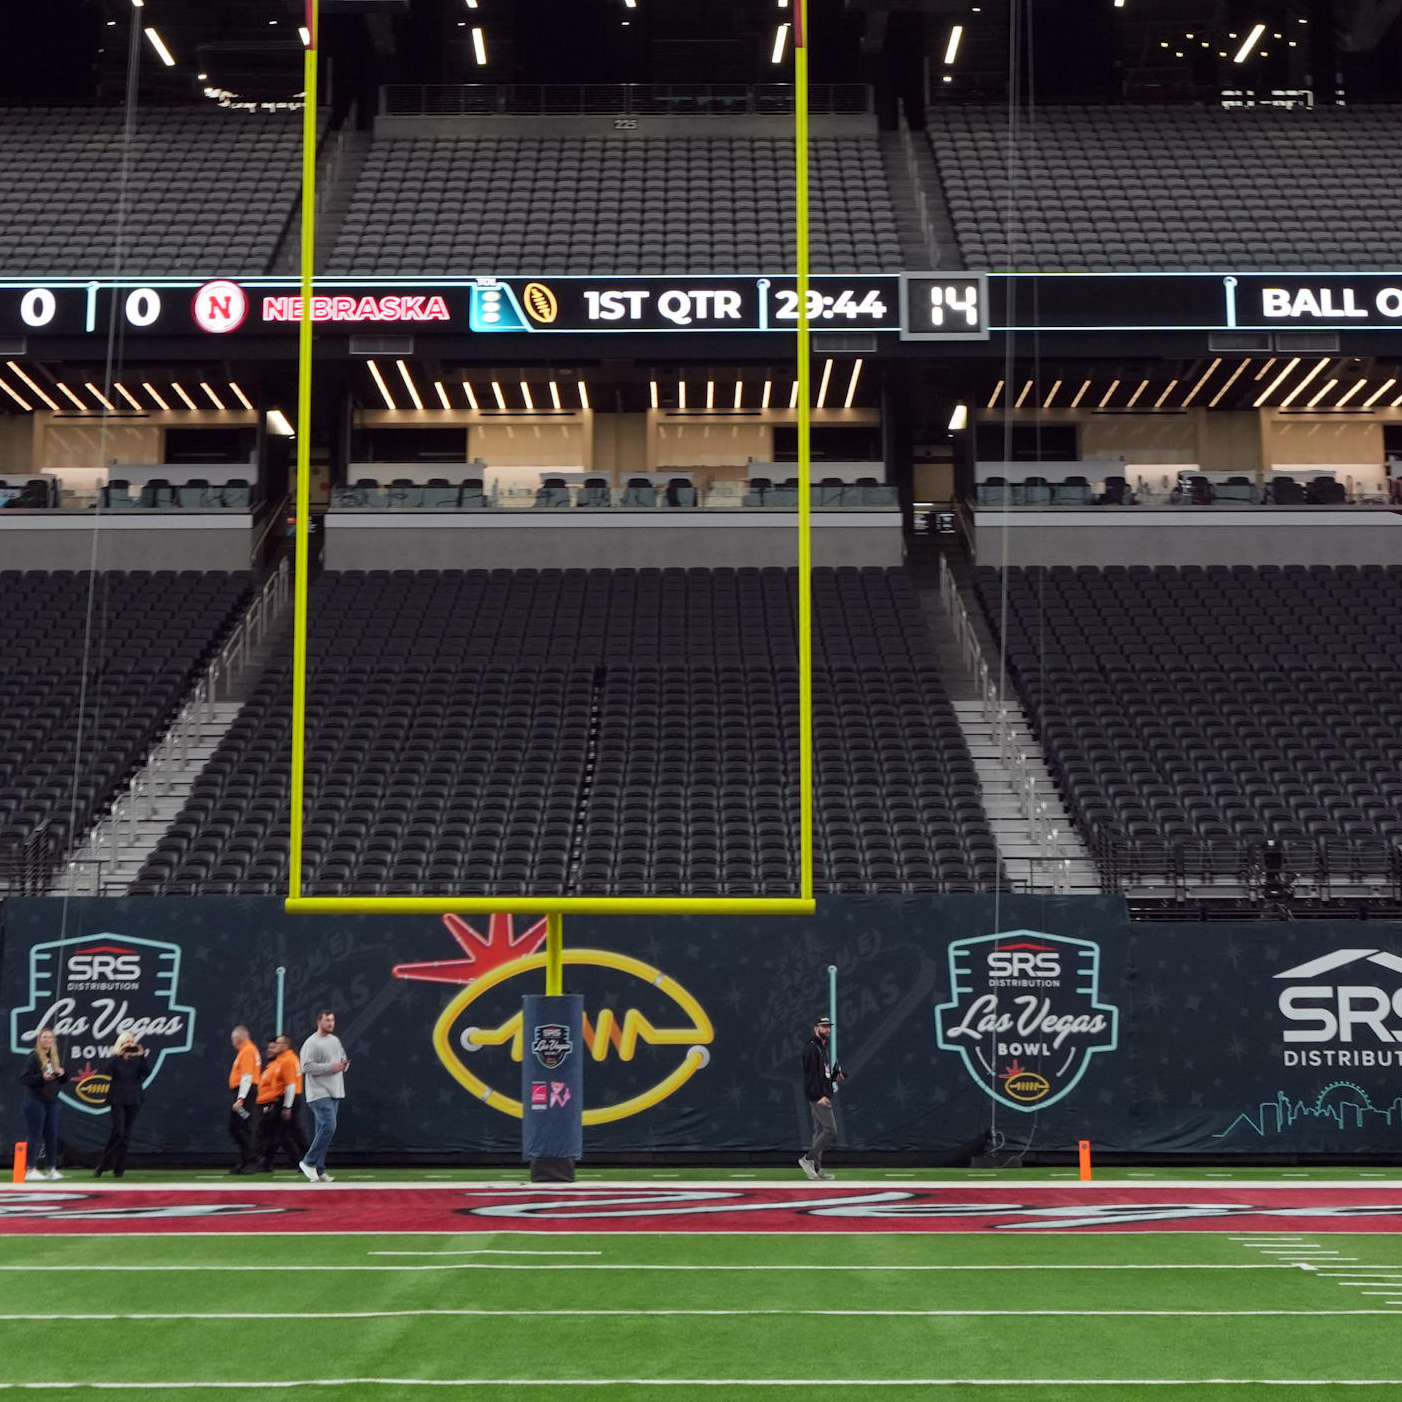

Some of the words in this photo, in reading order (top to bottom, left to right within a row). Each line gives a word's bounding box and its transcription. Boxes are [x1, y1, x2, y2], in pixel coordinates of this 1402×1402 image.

[20, 288, 57, 327] 0
[125, 288, 161, 327] 0
[208, 295, 232, 320] N
[262, 295, 451, 321] NEBRASKA
[583, 290, 649, 320] 1ST
[658, 290, 742, 324] QTR
[930, 285, 978, 326] 14
[1262, 288, 1368, 318] BALL
[68, 955, 141, 981] SRS
[987, 953, 1061, 978] SRS
[67, 982, 140, 991] DISTRIBUTION
[988, 979, 1061, 988] DISTRIBUTION
[21, 998, 89, 1041] Las
[90, 998, 183, 1047] Vegas
[947, 994, 1014, 1039] Las
[1014, 995, 1107, 1049] Vegas
[71, 1045, 117, 1059] BOW
[998, 1042, 1051, 1057] BOWL
